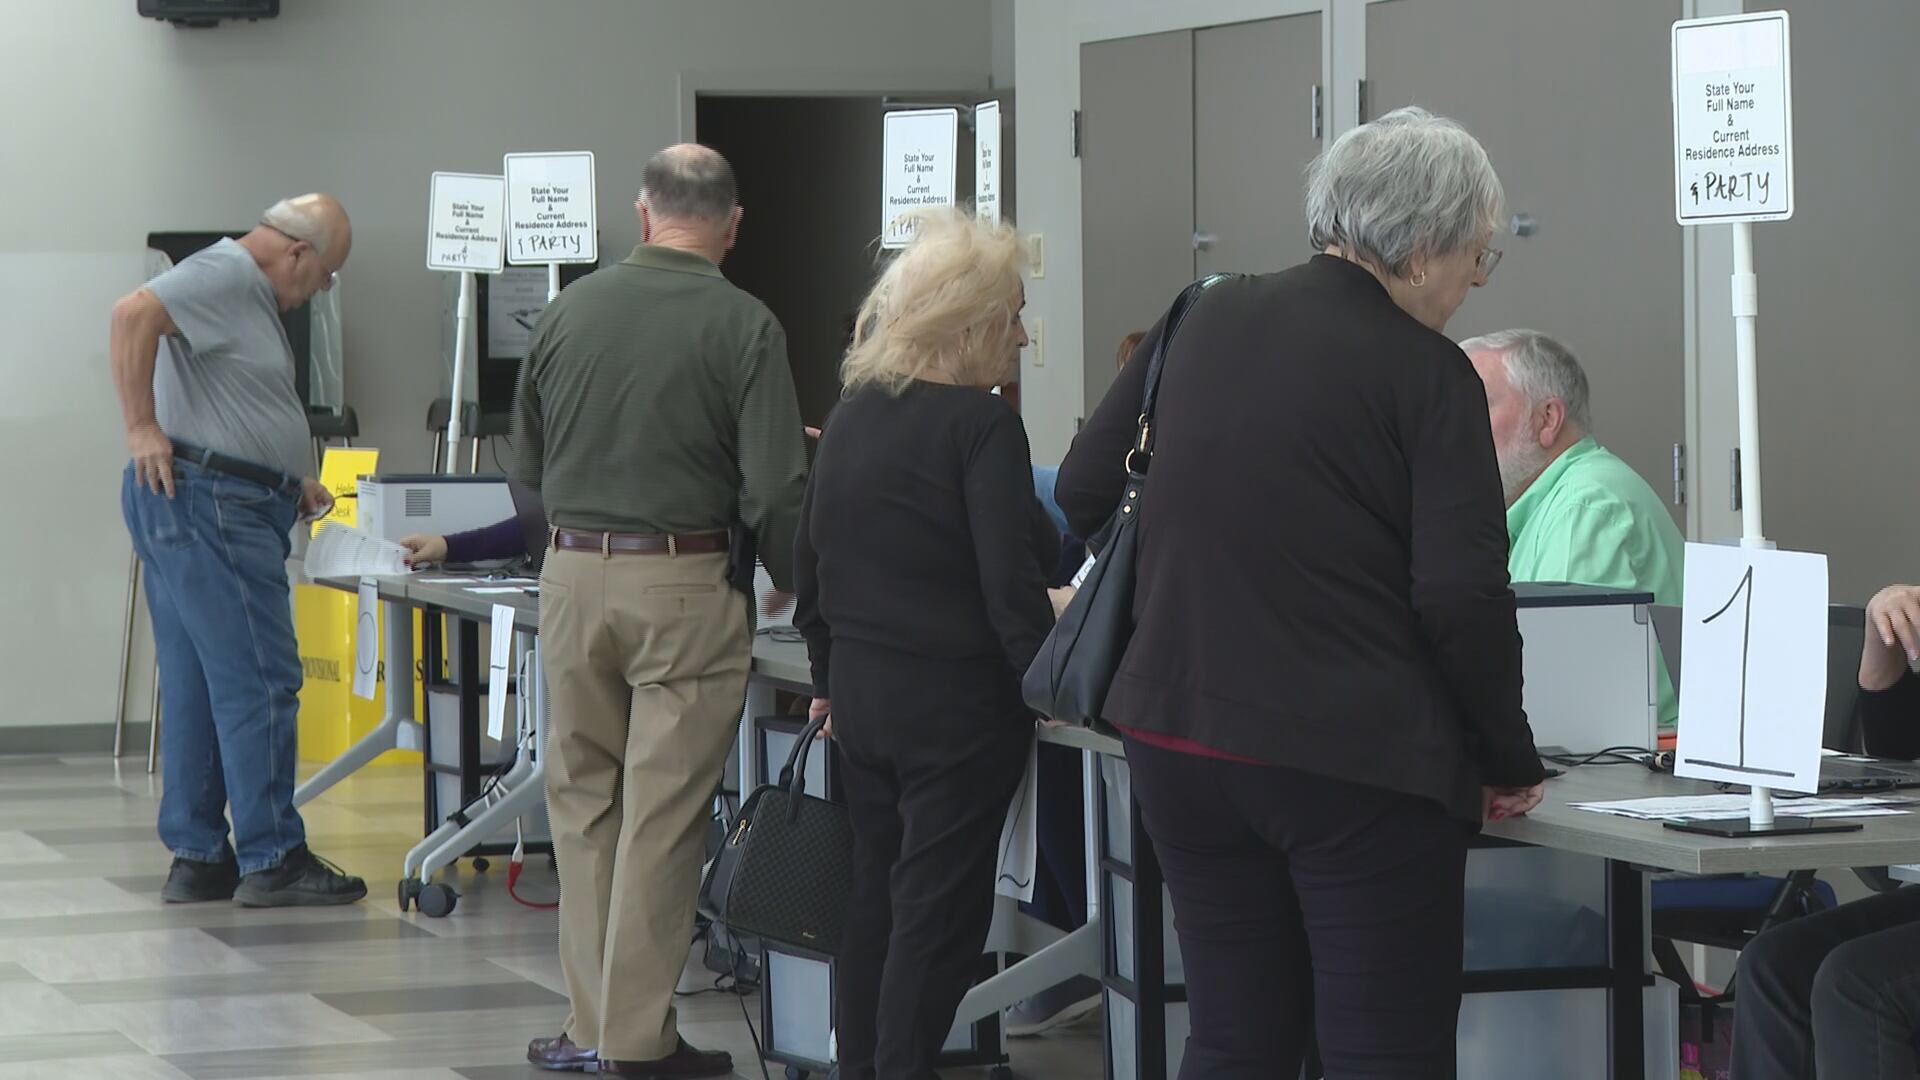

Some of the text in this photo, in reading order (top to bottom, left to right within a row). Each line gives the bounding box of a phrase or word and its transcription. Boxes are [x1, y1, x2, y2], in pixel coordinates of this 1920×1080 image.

[1705, 81, 1755, 97] State Your
[1706, 97, 1755, 112] Full Name
[1727, 114, 1734, 126] &
[1713, 129, 1750, 144] Current
[904, 152, 935, 163] State Your
[1685, 143, 1780, 161] Residence Address
[904, 163, 934, 173] Full Name
[916, 174, 921, 184] &
[530, 187, 569, 195] State Your
[907, 185, 930, 194] Current
[1704, 171, 1770, 205] PARTY
[531, 195, 569, 203] Full Name
[889, 195, 948, 206] Residence Address
[452, 203, 485, 212] State Your
[547, 204, 553, 212] &
[465, 211, 484, 219] Name
[454, 225, 480, 234] Current
[514, 220, 588, 230] Residence Address
[435, 232, 498, 243] Residence Address
[529, 234, 581, 255] PARTY
[441, 253, 469, 264] PARTY
[1684, 563, 1796, 779] 1
